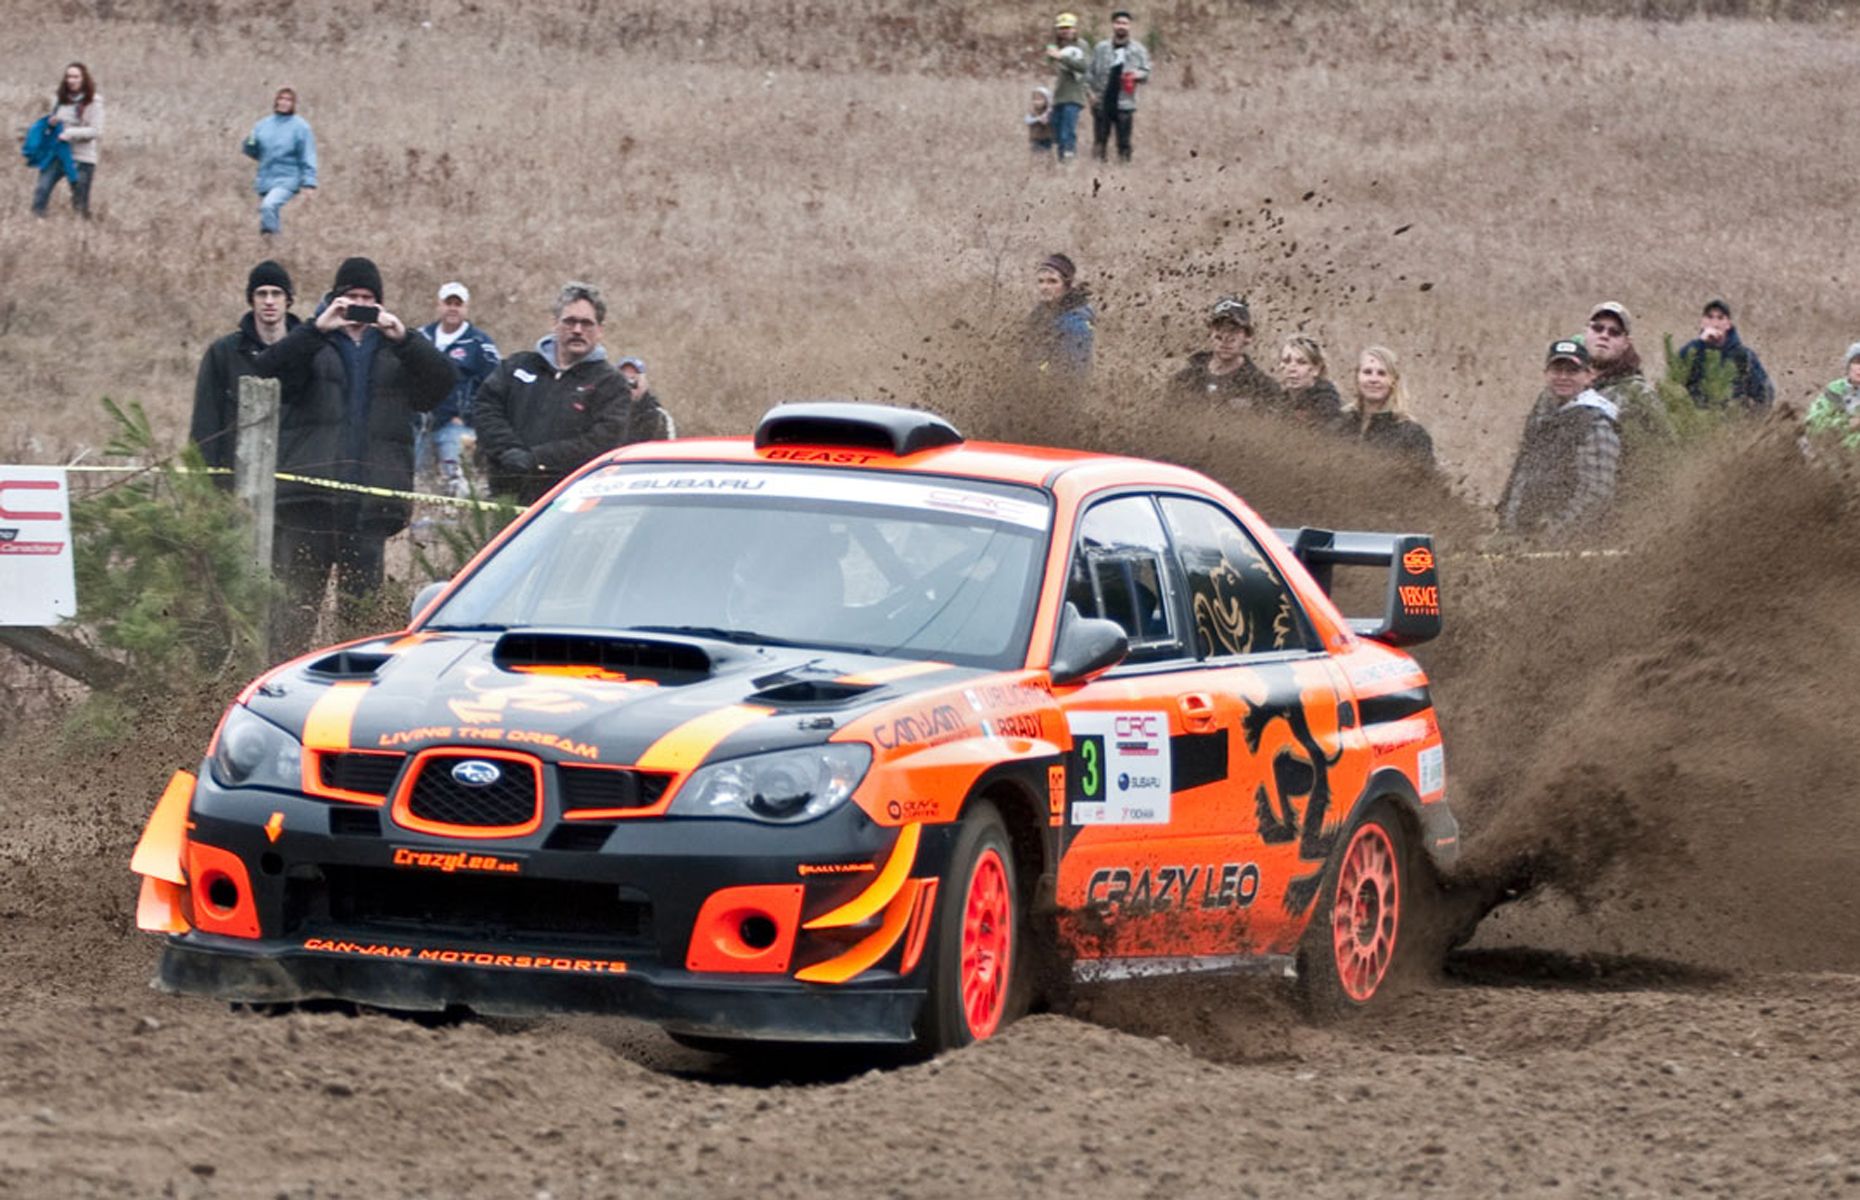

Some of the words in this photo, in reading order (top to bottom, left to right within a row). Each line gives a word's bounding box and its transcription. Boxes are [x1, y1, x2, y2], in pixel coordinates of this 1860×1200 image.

[765, 450, 879, 464] BEAST
[628, 478, 766, 490] SUBARU
[1399, 586, 1438, 607] VERSACE
[1115, 716, 1158, 737] CRC
[379, 726, 452, 746] LIVING
[459, 726, 504, 740] THE
[507, 728, 598, 759] DREAM
[1082, 739, 1098, 796] 3
[1131, 776, 1160, 788] SUBARU
[1087, 864, 1199, 911] CRAZY
[1201, 861, 1260, 910] LEO
[303, 938, 411, 959] CAN-JAM
[418, 949, 628, 973] MOTORSPORTS
